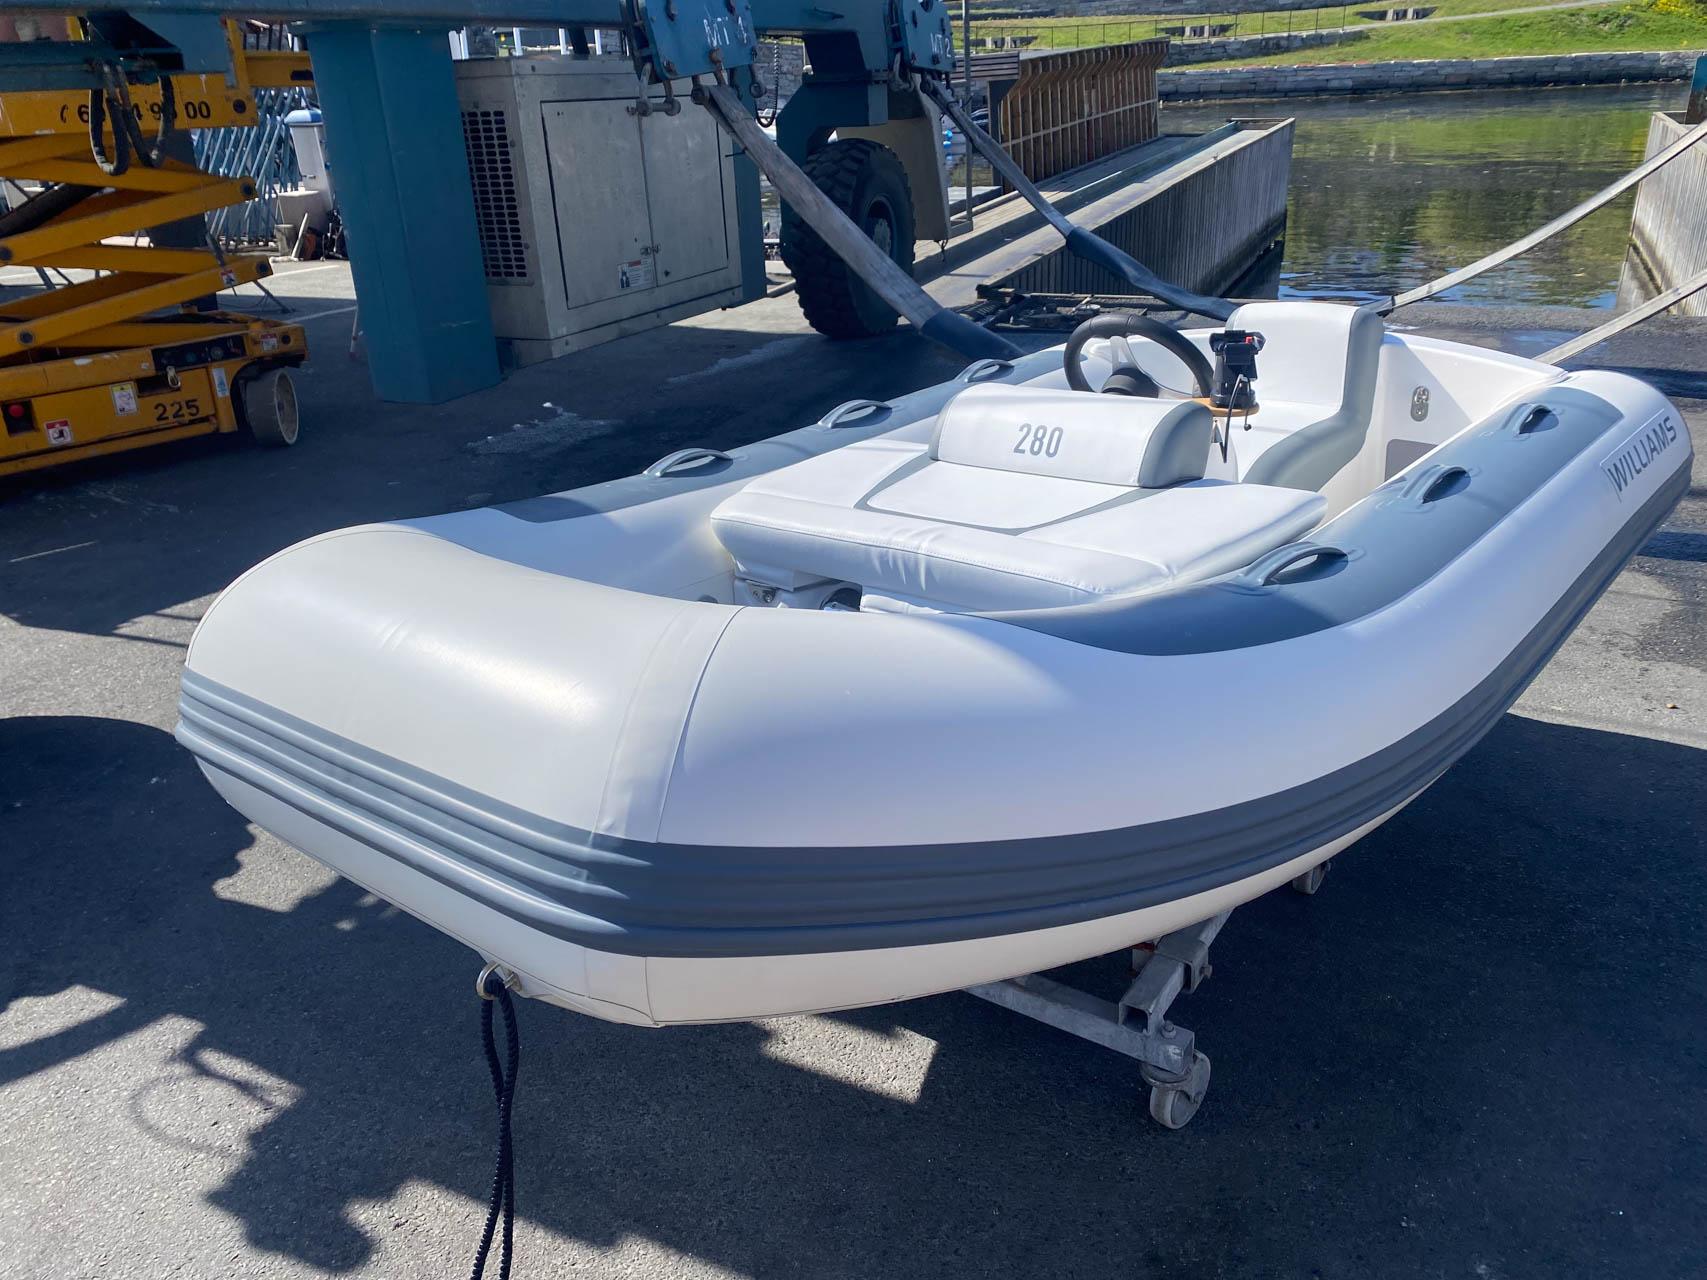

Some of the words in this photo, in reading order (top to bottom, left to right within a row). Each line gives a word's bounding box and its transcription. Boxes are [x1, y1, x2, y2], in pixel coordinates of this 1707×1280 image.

[184, 100, 211, 120] 00
[154, 399, 200, 422] 225
[1013, 422, 1064, 458] 280
[1607, 416, 1677, 493] WILLIAMS
